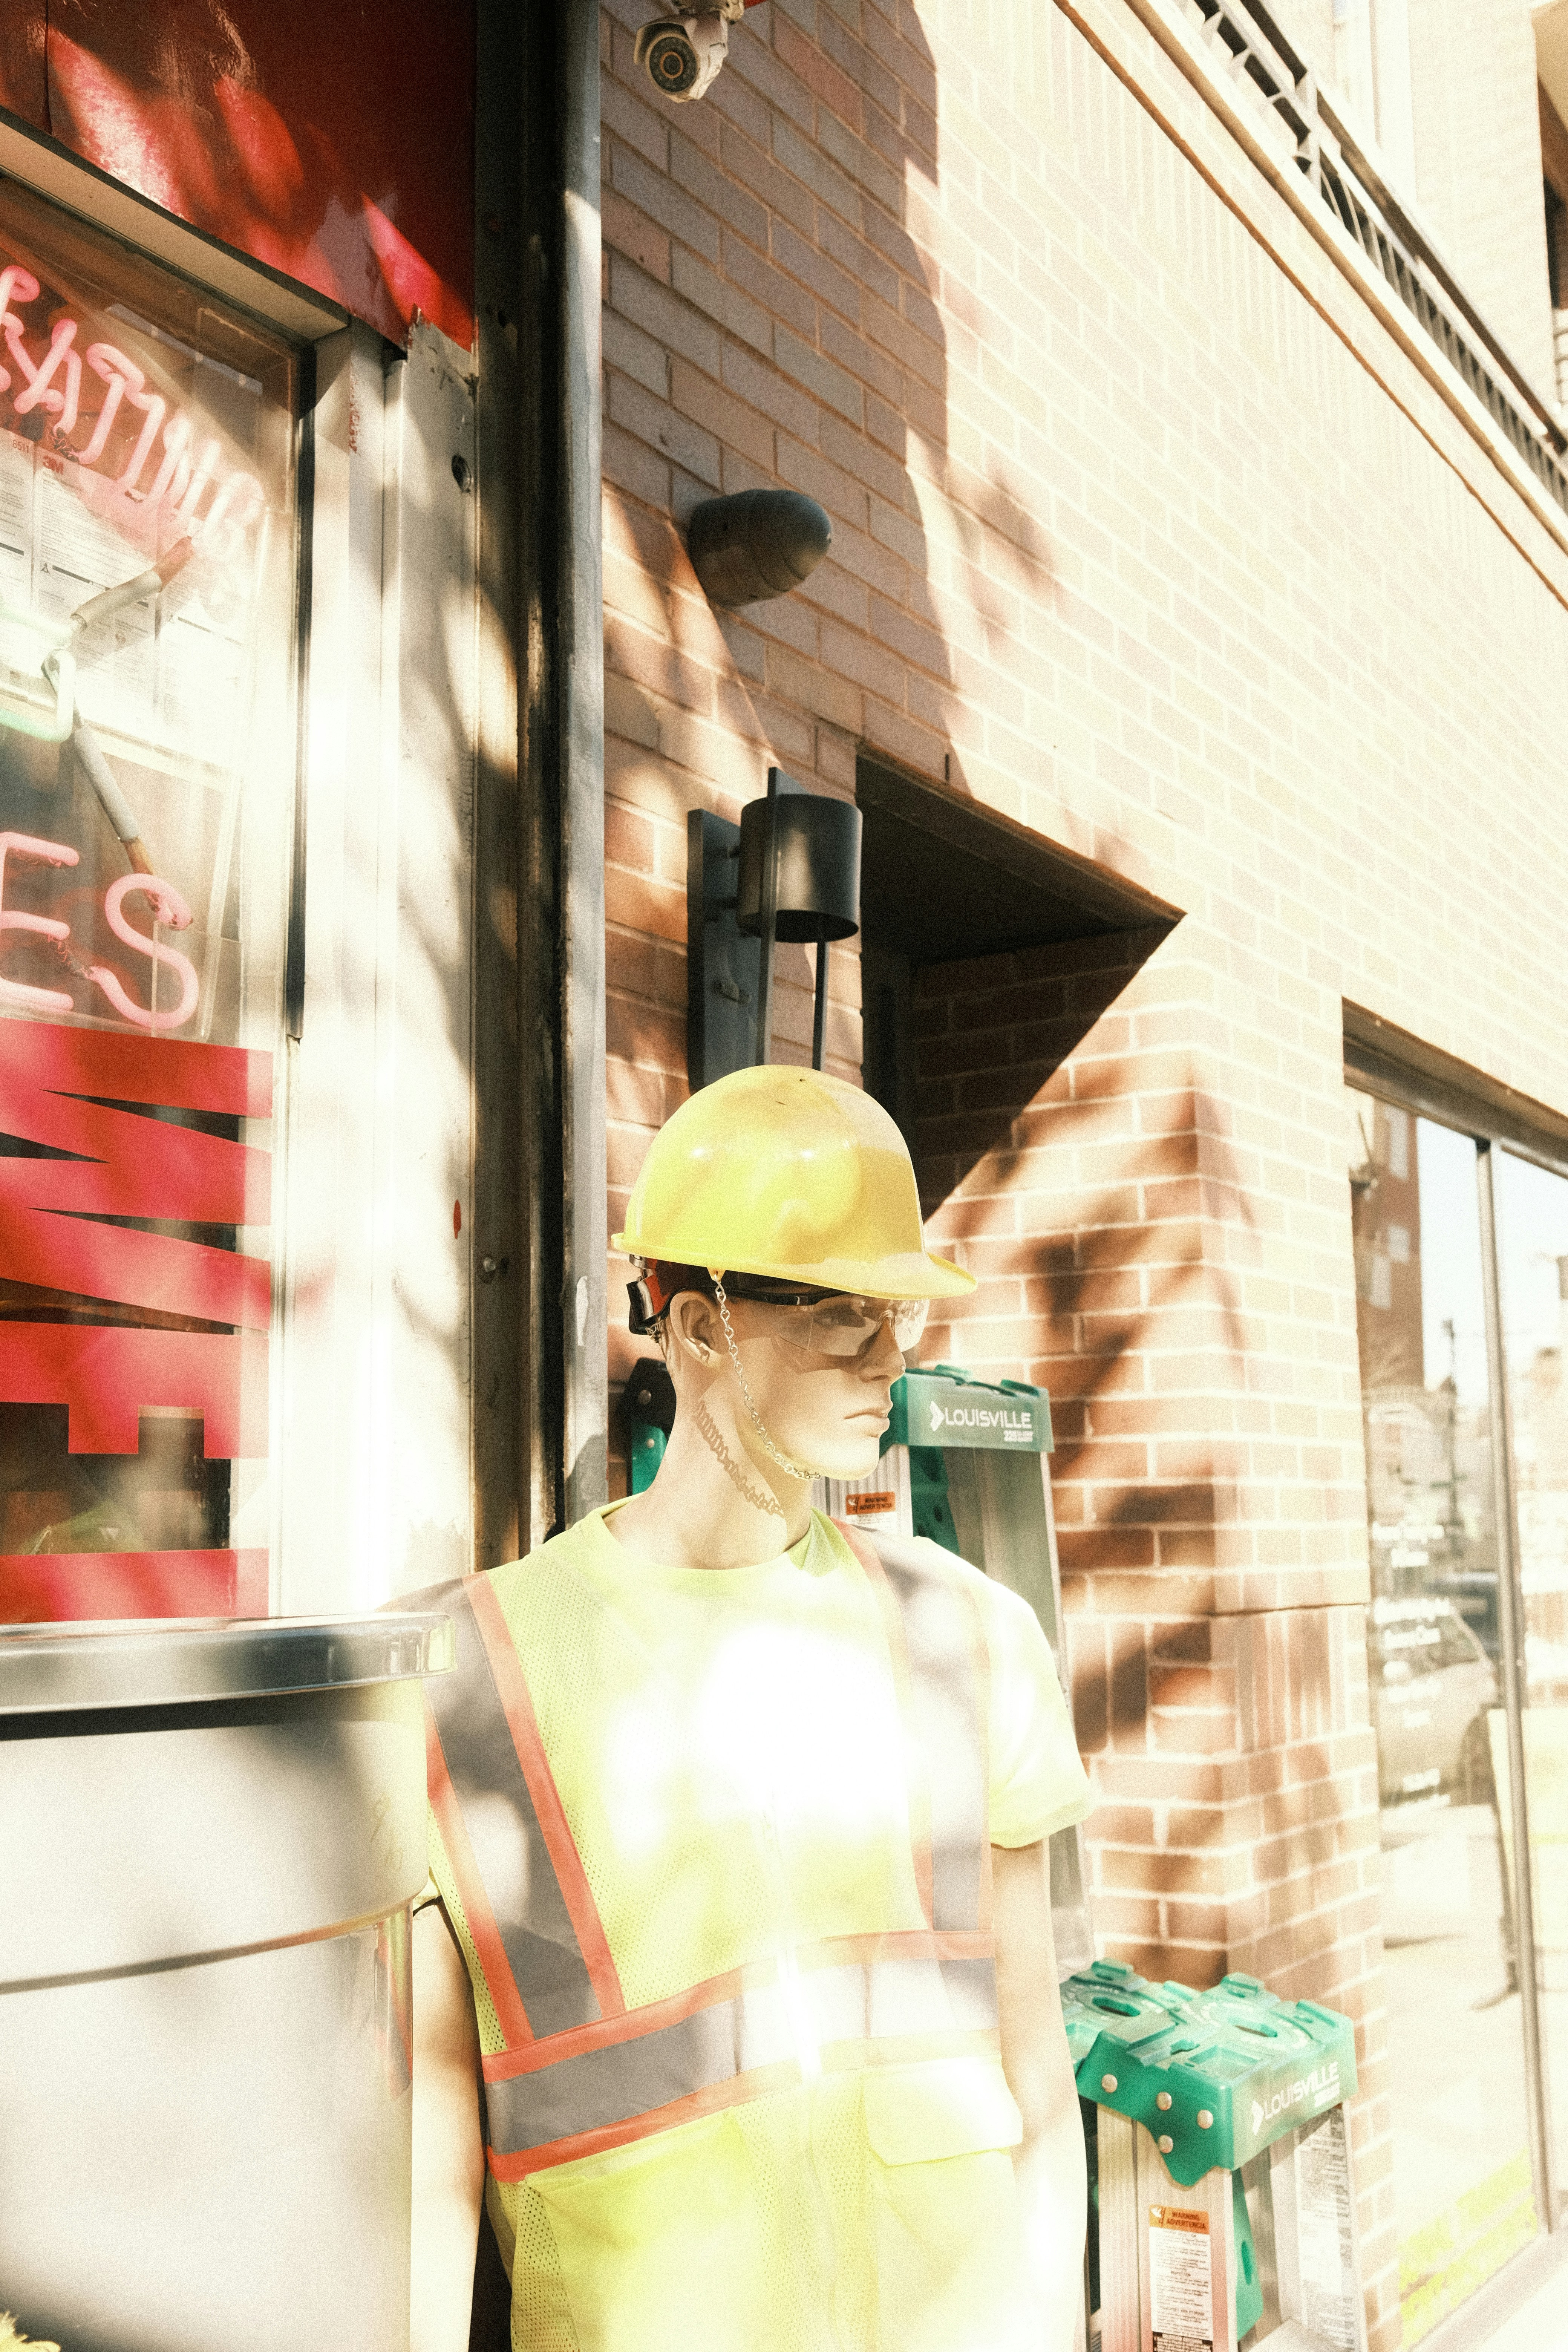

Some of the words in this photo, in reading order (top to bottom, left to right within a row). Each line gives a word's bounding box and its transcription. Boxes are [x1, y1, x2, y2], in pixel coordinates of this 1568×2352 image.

[12, 439, 30, 454] 8511
[42, 455, 64, 475] 3M
[944, 1407, 1032, 1429] LOUISVILLE
[1263, 2061, 1340, 2120] LOUISVILLE
[1166, 2218, 1206, 2229] ADVERTENCIA
[1172, 2211, 1200, 2221] WARNING
